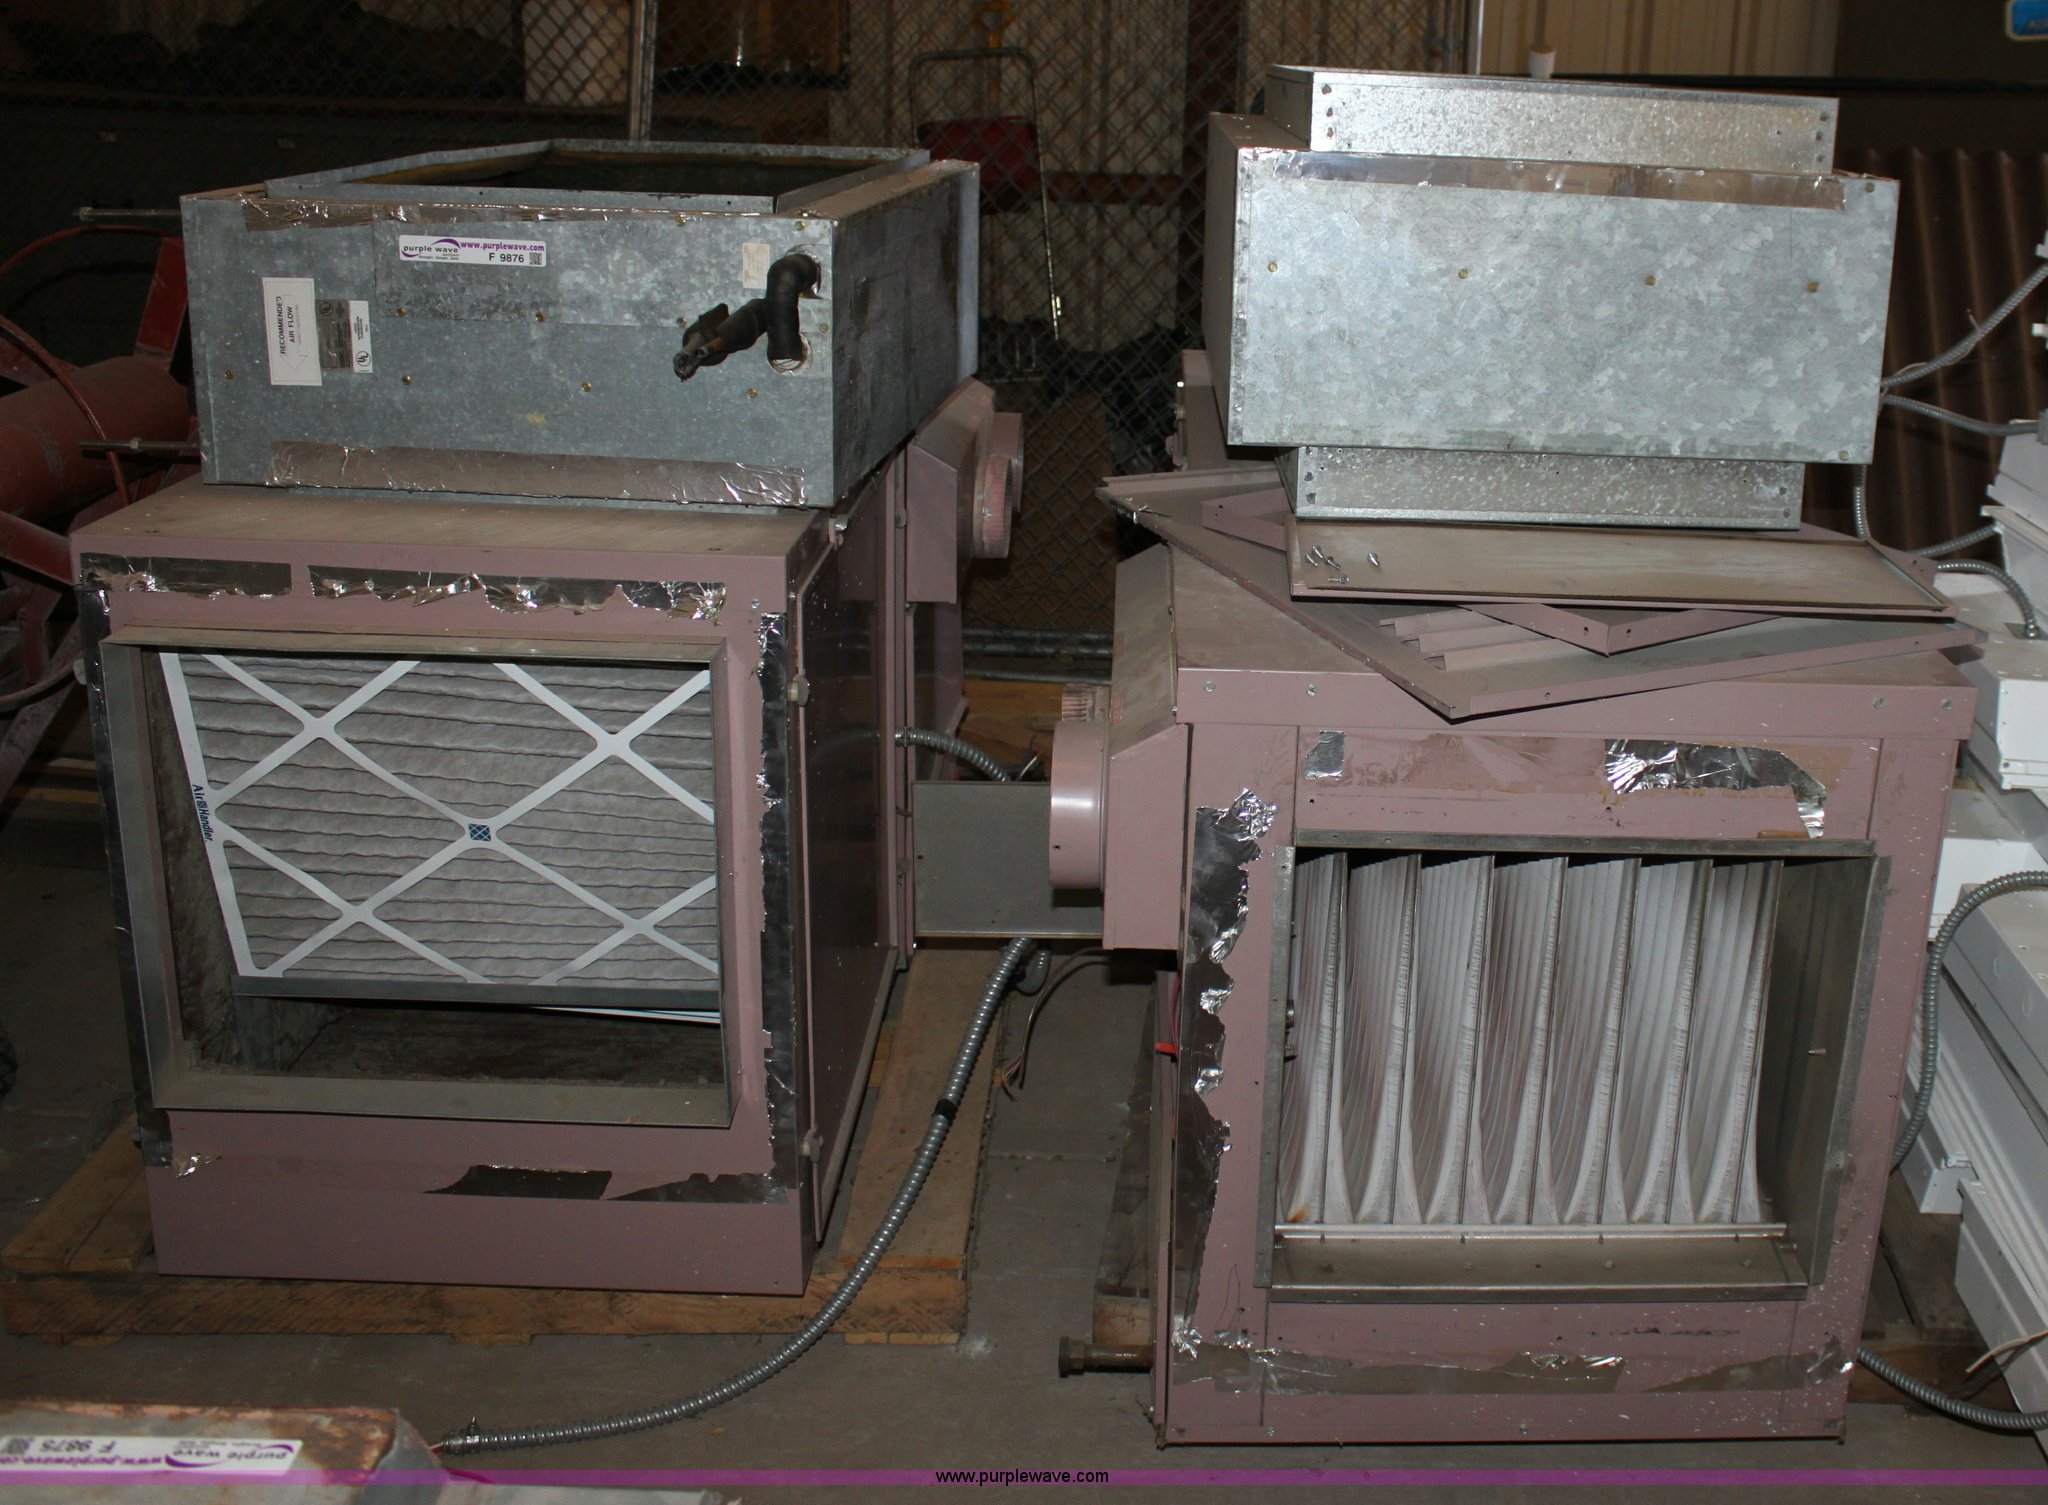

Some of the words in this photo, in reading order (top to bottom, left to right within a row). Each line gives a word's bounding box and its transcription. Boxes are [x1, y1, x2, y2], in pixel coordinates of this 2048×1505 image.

[461, 241, 545, 251] www.purplewave.com
[489, 252, 496, 261] F
[500, 253, 525, 262] 9876
[286, 306, 295, 328] FLOW
[275, 296, 286, 354] RECOMMENDED
[288, 330, 296, 343] AIR
[0, 1455, 162, 1467] www.purplewave.co
